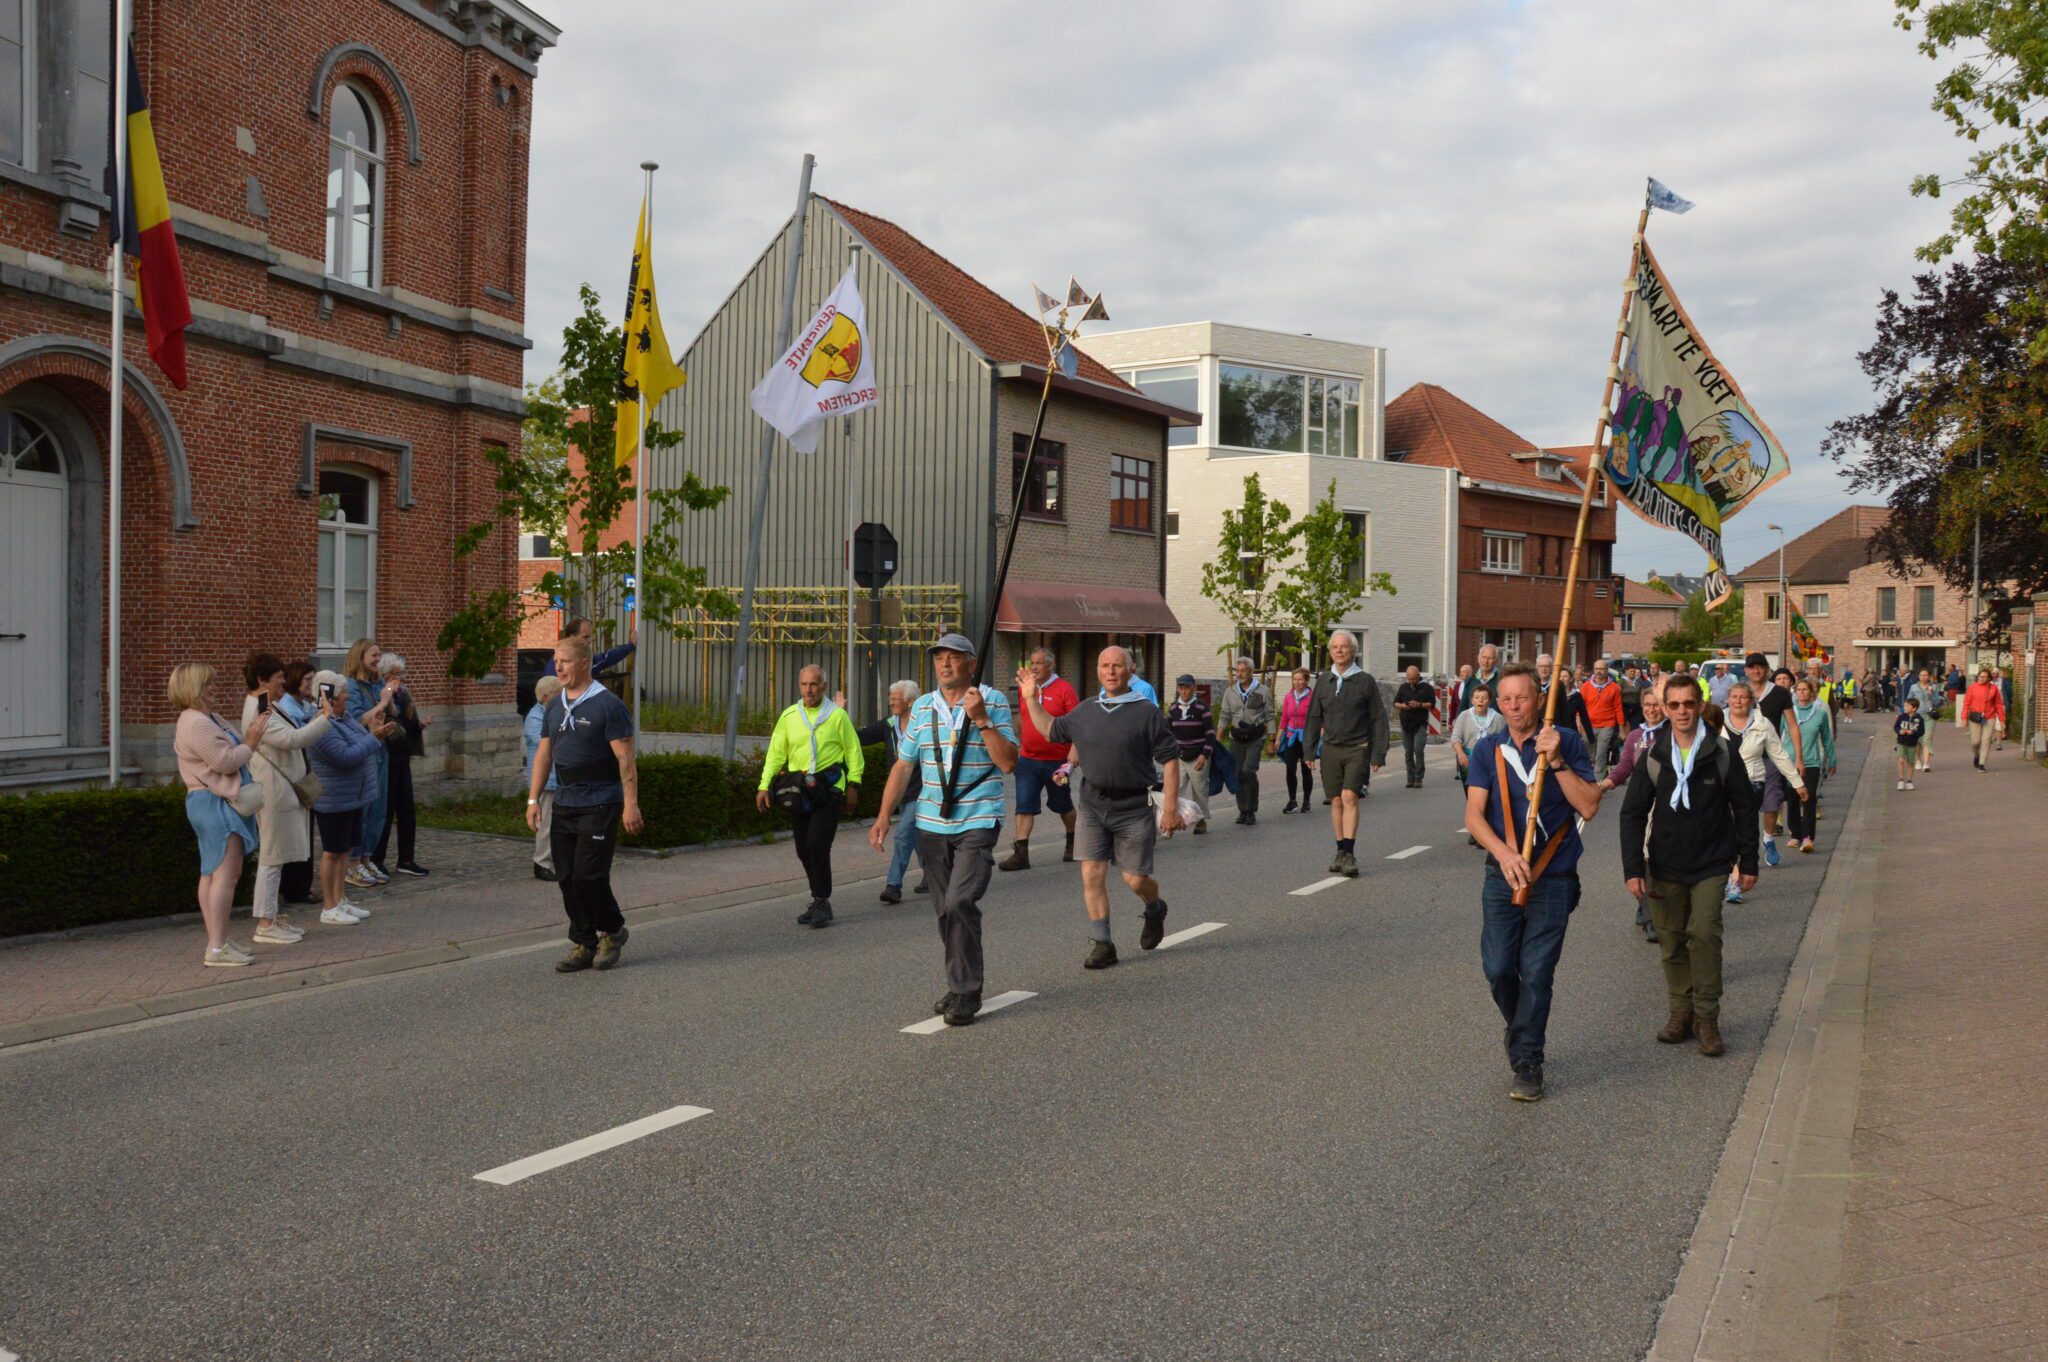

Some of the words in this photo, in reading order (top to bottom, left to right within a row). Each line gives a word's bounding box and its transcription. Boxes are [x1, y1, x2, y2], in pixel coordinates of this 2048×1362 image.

[1673, 334, 1702, 362] TE
[1694, 358, 1736, 405] VOET
[1865, 626, 1903, 638] OPTIEK
